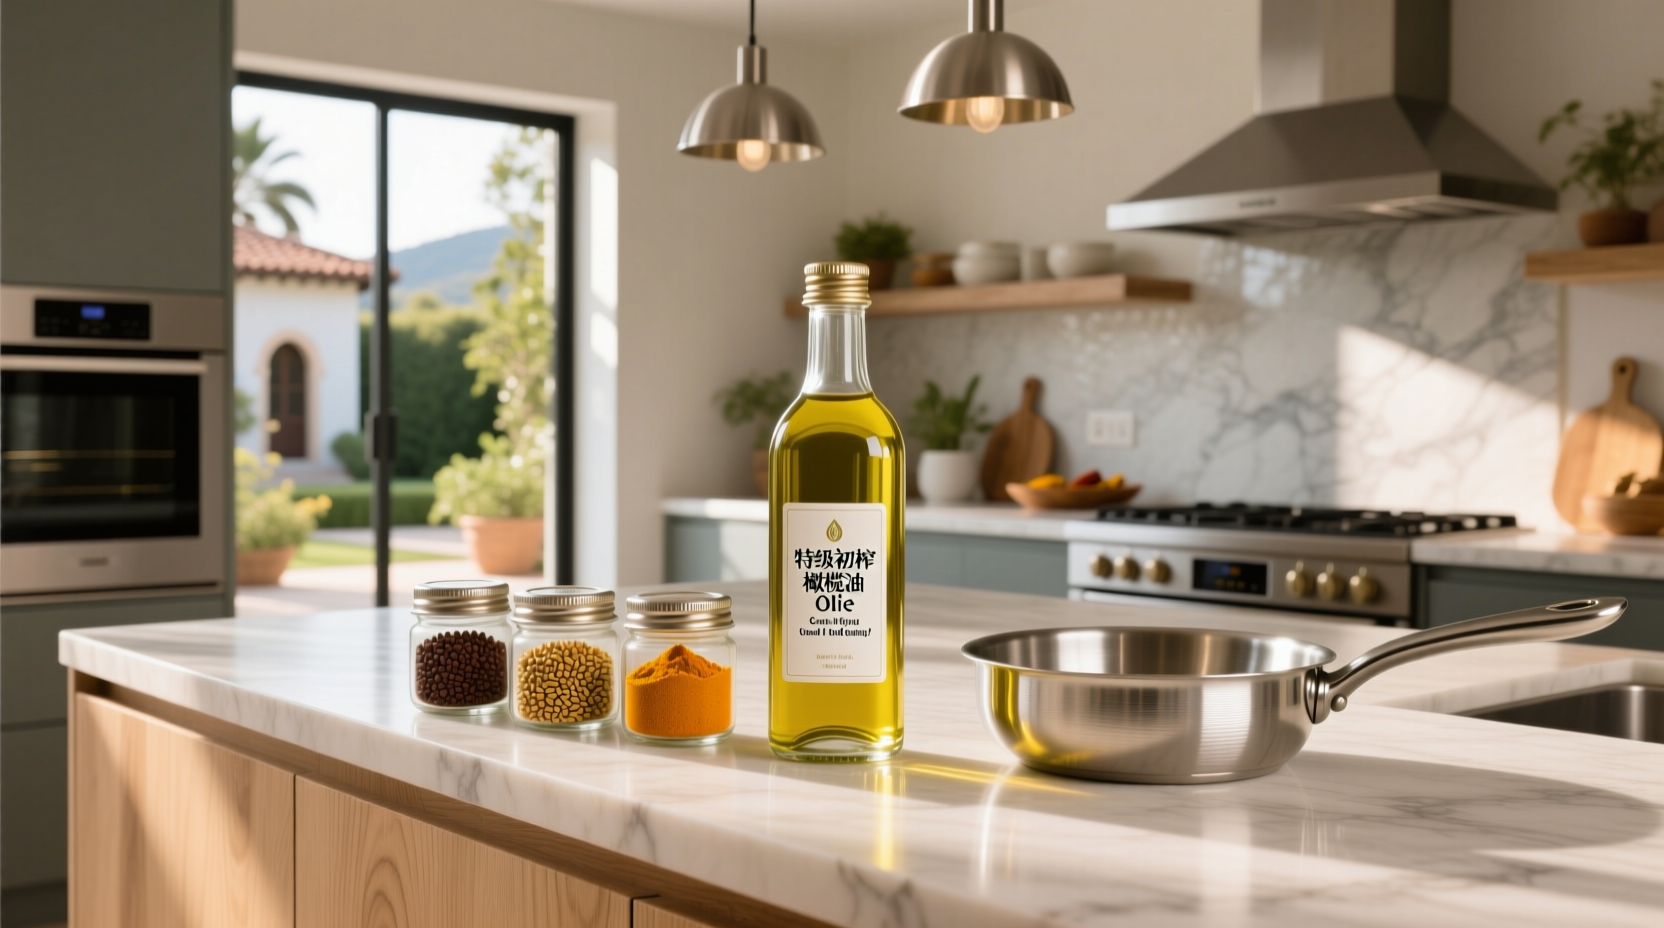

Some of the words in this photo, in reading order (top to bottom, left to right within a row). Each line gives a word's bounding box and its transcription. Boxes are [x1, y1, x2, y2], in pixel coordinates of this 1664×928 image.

[794, 548, 876, 570] 特级初榨
[802, 571, 864, 593] 橄榄油
[815, 594, 855, 612] Olie
